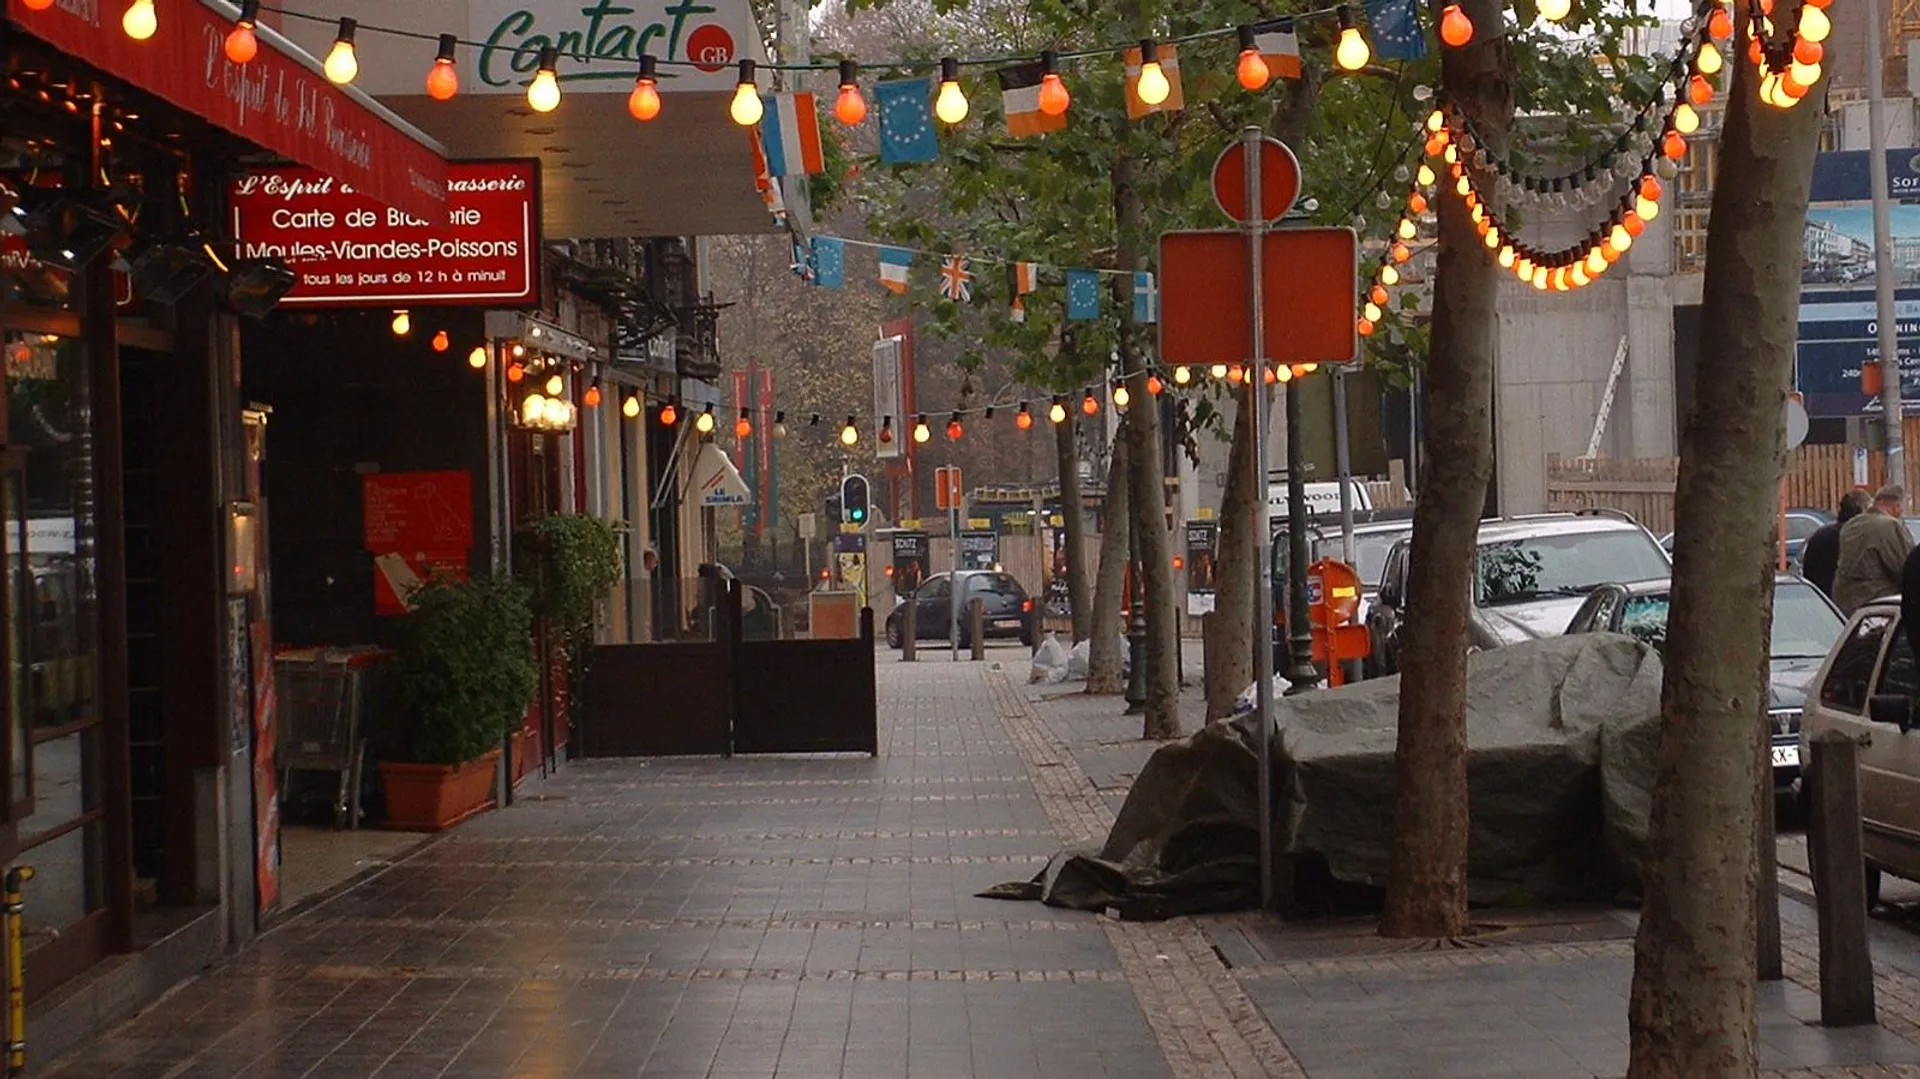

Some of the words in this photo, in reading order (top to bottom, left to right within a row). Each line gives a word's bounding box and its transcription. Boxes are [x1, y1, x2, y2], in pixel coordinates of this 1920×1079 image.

[478, 0, 716, 86] Contact
[699, 46, 728, 64] GB
[234, 174, 334, 201] L'Esprit
[448, 174, 526, 191] rasserie
[272, 208, 335, 229] Carte
[345, 207, 376, 228] de
[246, 238, 518, 260] Moules-Viandes-Poissons
[303, 272, 331, 285] tous
[335, 272, 354, 285] les
[358, 272, 388, 286] jours
[392, 271, 412, 283] de
[417, 270, 433, 283] 12
[438, 270, 447, 282] h
[452, 268, 462, 282] à
[467, 269, 506, 282] minuit
